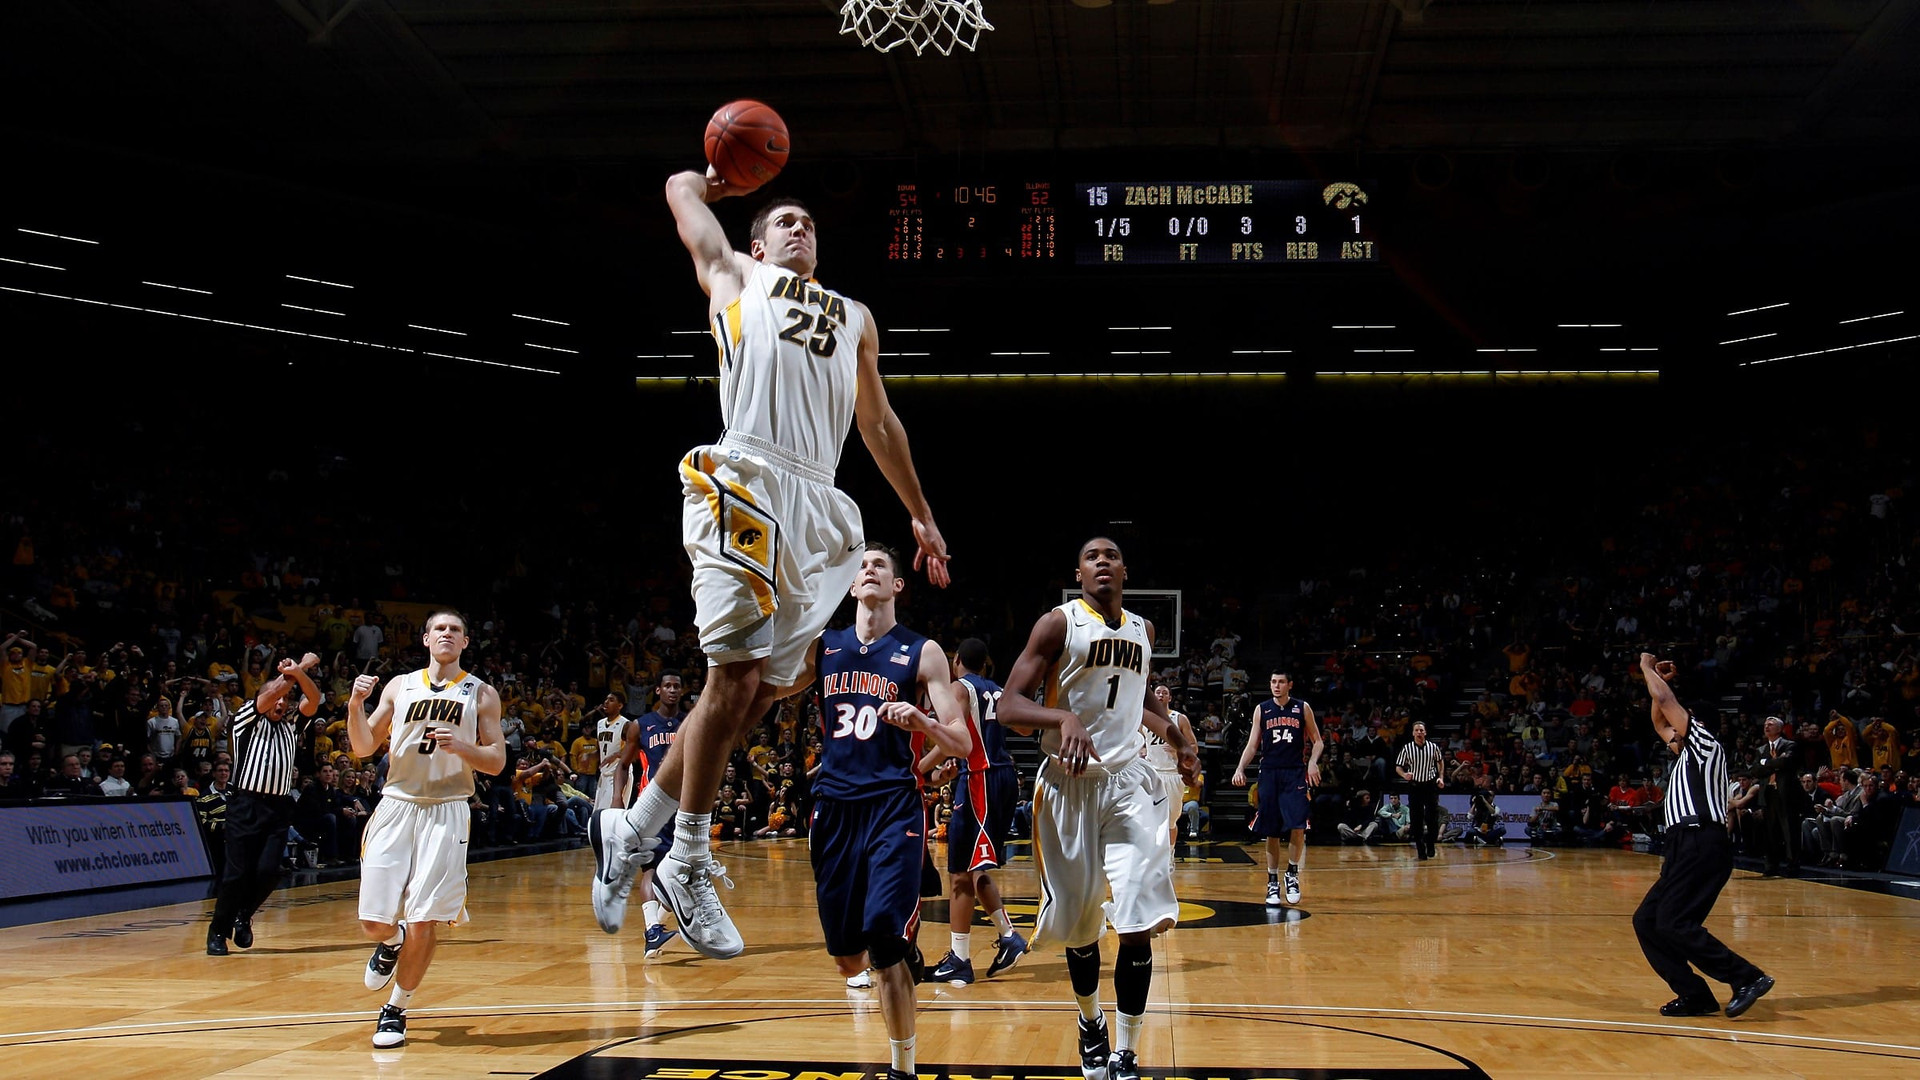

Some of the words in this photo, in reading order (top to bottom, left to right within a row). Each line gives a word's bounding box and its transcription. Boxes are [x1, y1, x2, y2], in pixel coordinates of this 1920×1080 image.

[900, 194, 917, 206] 54
[1032, 192, 1049, 205] 62
[1087, 187, 1108, 206] 15
[1125, 186, 1171, 205] ZACH
[1177, 185, 1253, 205] McCABE
[968, 217, 975, 228] 2
[1021, 224, 1032, 232] 22
[1095, 218, 1130, 237] 1/5
[1241, 216, 1252, 235] 3
[1295, 215, 1307, 235] 3
[1351, 214, 1360, 234] 1
[937, 248, 944, 259] 2
[1005, 248, 1012, 257] 4
[1104, 244, 1124, 262] FG
[1180, 243, 1199, 261] FT
[1232, 242, 1264, 260] PTS
[1286, 241, 1319, 260] REB
[1341, 241, 1374, 259] AST
[779, 308, 838, 358] 25
[1084, 638, 1144, 676] IOWA
[824, 671, 899, 703] ILLINOIS
[1105, 673, 1121, 711] 1
[403, 698, 465, 727] IOWA
[832, 702, 878, 741] 30
[418, 726, 437, 754] 5
[1272, 728, 1294, 744] 54
[25, 824, 61, 845] With
[62, 828, 88, 847] you
[90, 823, 126, 842] when
[127, 821, 137, 838] it
[138, 820, 186, 837] matters.
